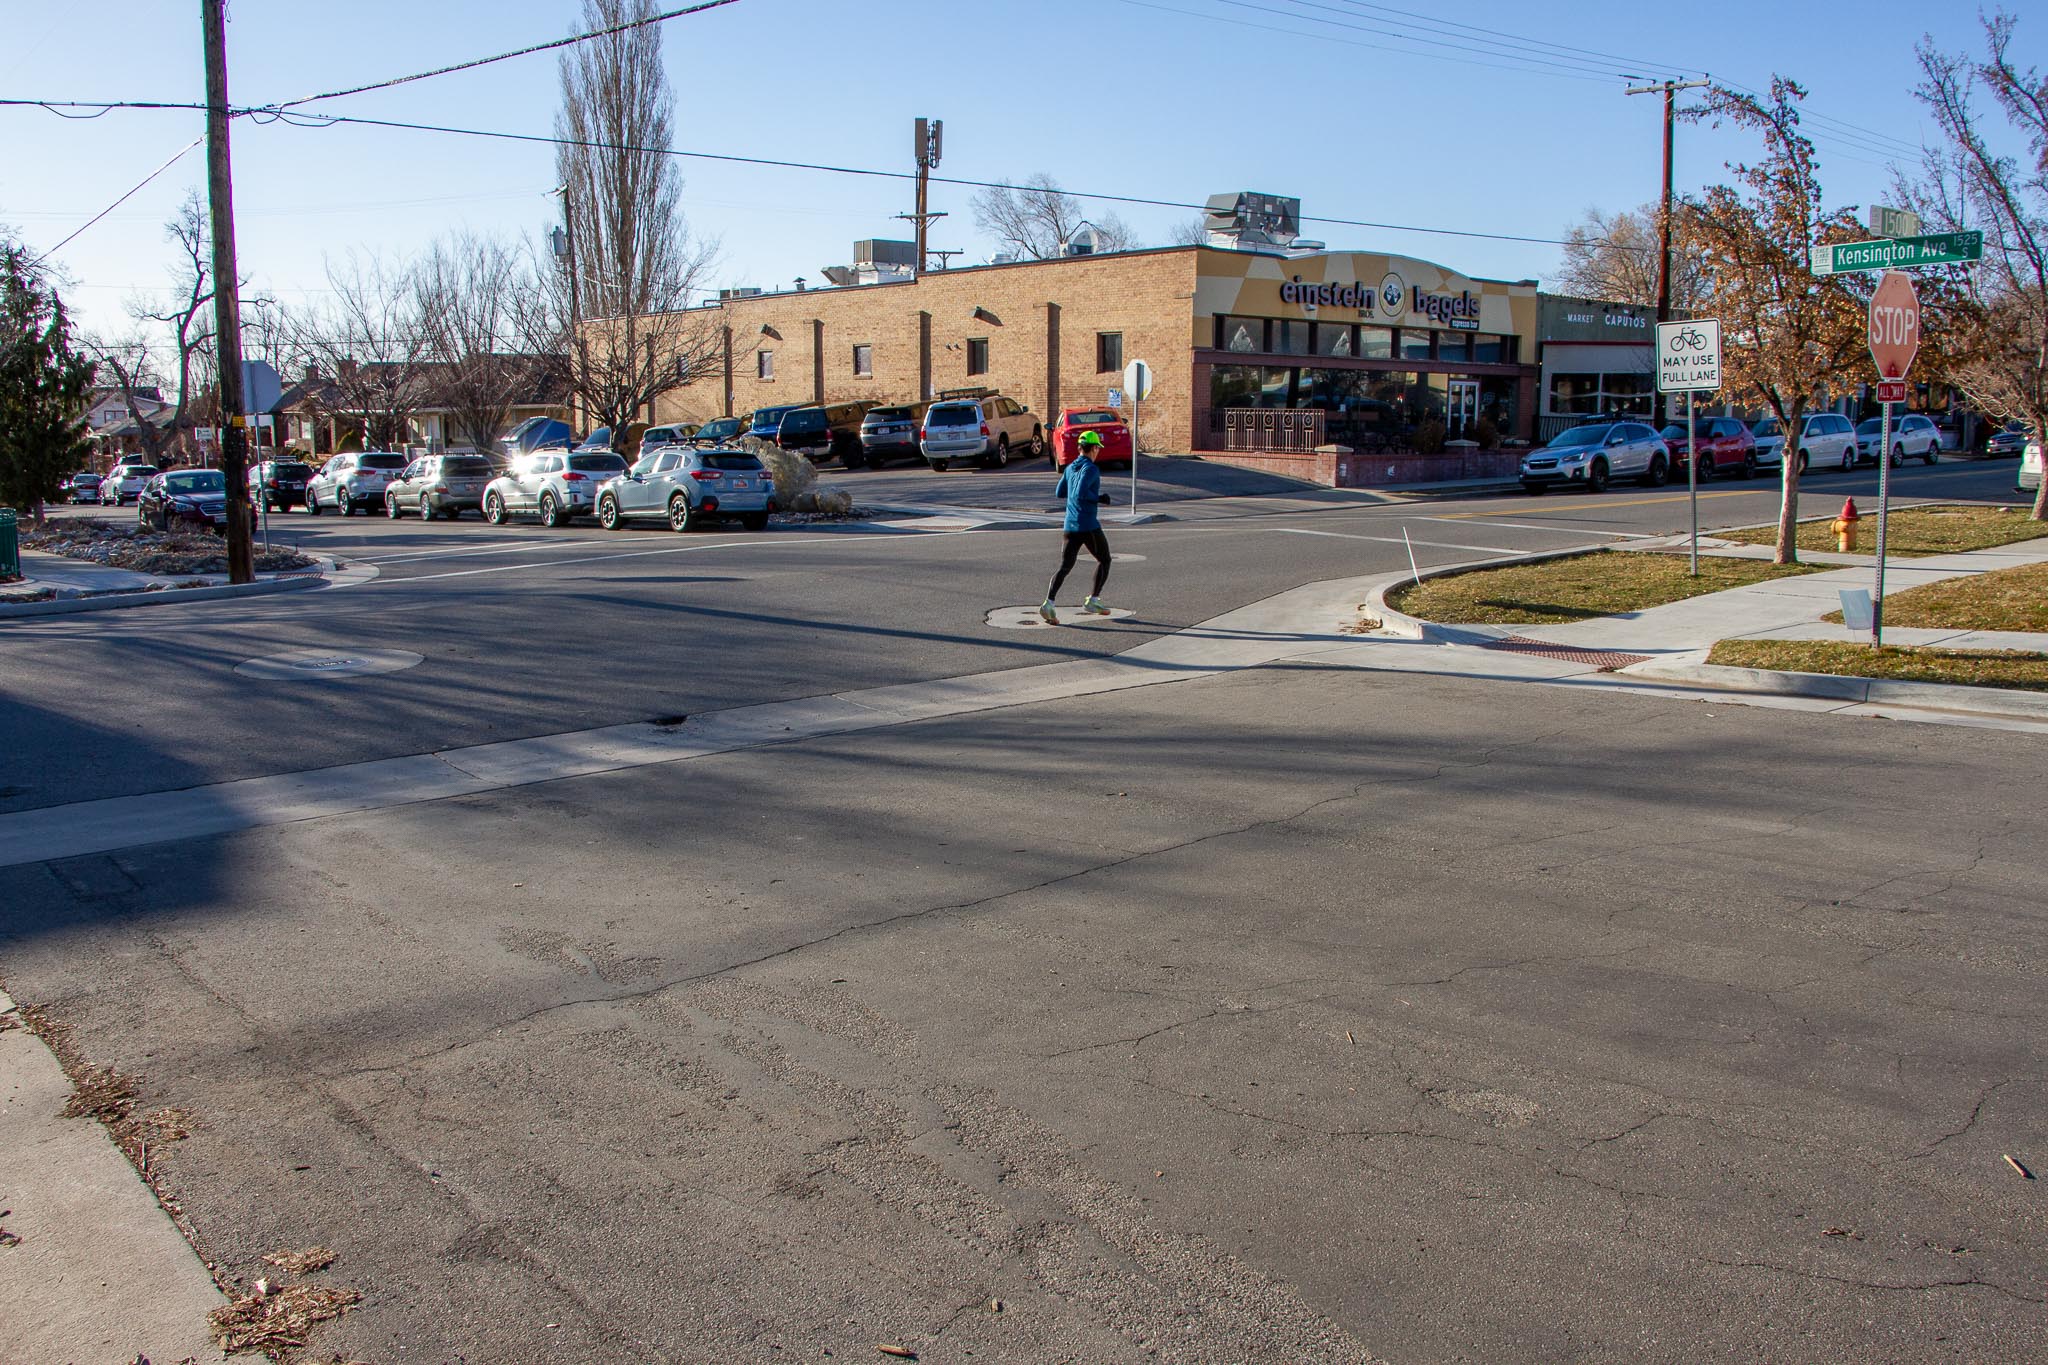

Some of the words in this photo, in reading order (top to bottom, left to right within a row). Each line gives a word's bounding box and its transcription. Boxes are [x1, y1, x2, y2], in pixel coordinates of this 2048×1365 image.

[1953, 233, 1978, 247] 1525
[1837, 244, 1915, 266] Kensington
[1921, 240, 1947, 258] Ave
[1961, 247, 1969, 258] S
[1280, 275, 1376, 309] einstein
[1413, 285, 1481, 323] bagels
[1567, 313, 1594, 323] MARKET
[1872, 307, 1915, 346] STOP
[1663, 356, 1688, 367] MAY
[1692, 354, 1714, 365] USE
[1662, 371, 1687, 382] FULL
[1690, 370, 1716, 381] LANE
[1879, 386, 1890, 398] ALL
[1892, 386, 1904, 398] WAY
